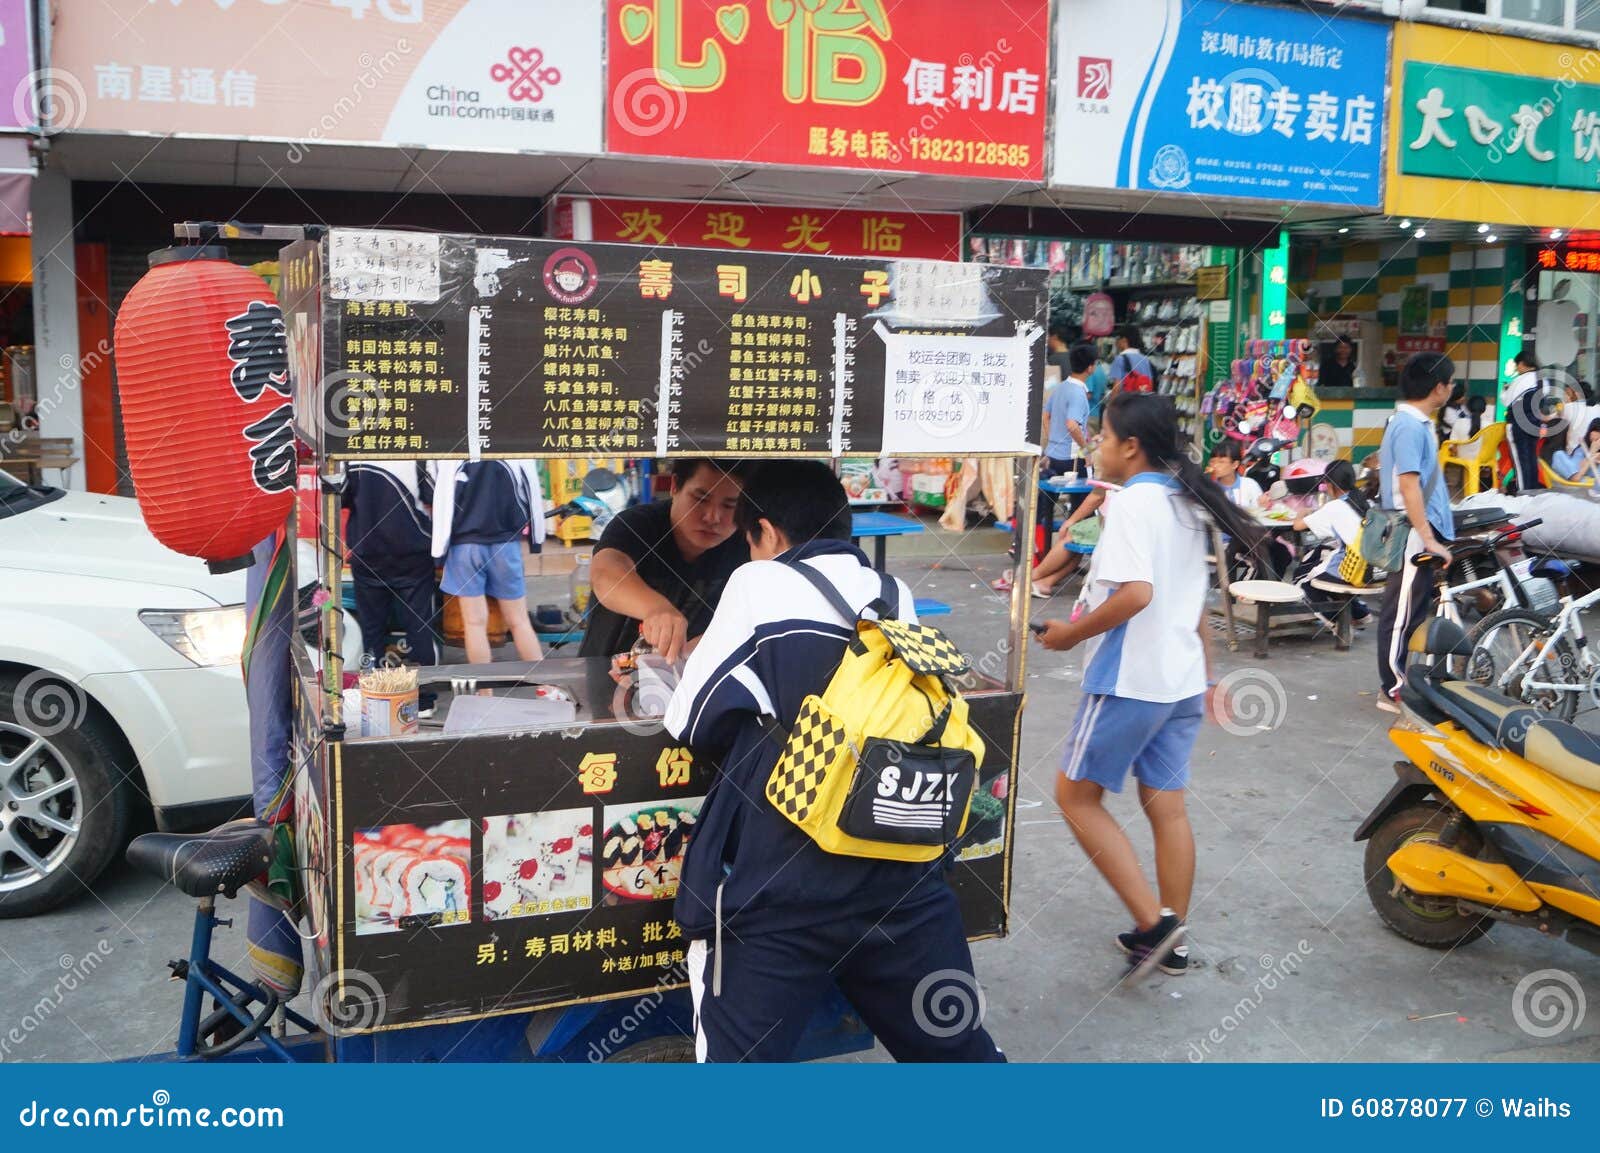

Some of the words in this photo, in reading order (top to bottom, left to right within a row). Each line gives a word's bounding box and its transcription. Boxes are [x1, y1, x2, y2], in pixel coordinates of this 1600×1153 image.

[1200, 30, 1343, 71] 深圳市教育局指定
[94, 63, 258, 108] 南星通信
[426, 85, 480, 102] China
[903, 58, 1039, 115] 便利店
[428, 104, 495, 119] unicom
[497, 106, 555, 122] 中国联通
[1186, 76, 1377, 146] 校服专卖店
[909, 137, 1029, 167] 13823128585
[616, 208, 905, 252] 欢迎光临
[346, 301, 414, 317] 海苔寿司：
[544, 325, 628, 341] 中华海草寿司
[346, 340, 444, 356] 韩国泡菜寿司：
[346, 359, 444, 374] 玉米香松寿司：
[544, 381, 620, 395] 吞拿鱼寿司：
[346, 416, 414, 431] 鱼仔寿司：
[346, 435, 430, 449] 红蟹仔寿司：
[578, 747, 694, 795] 每份
